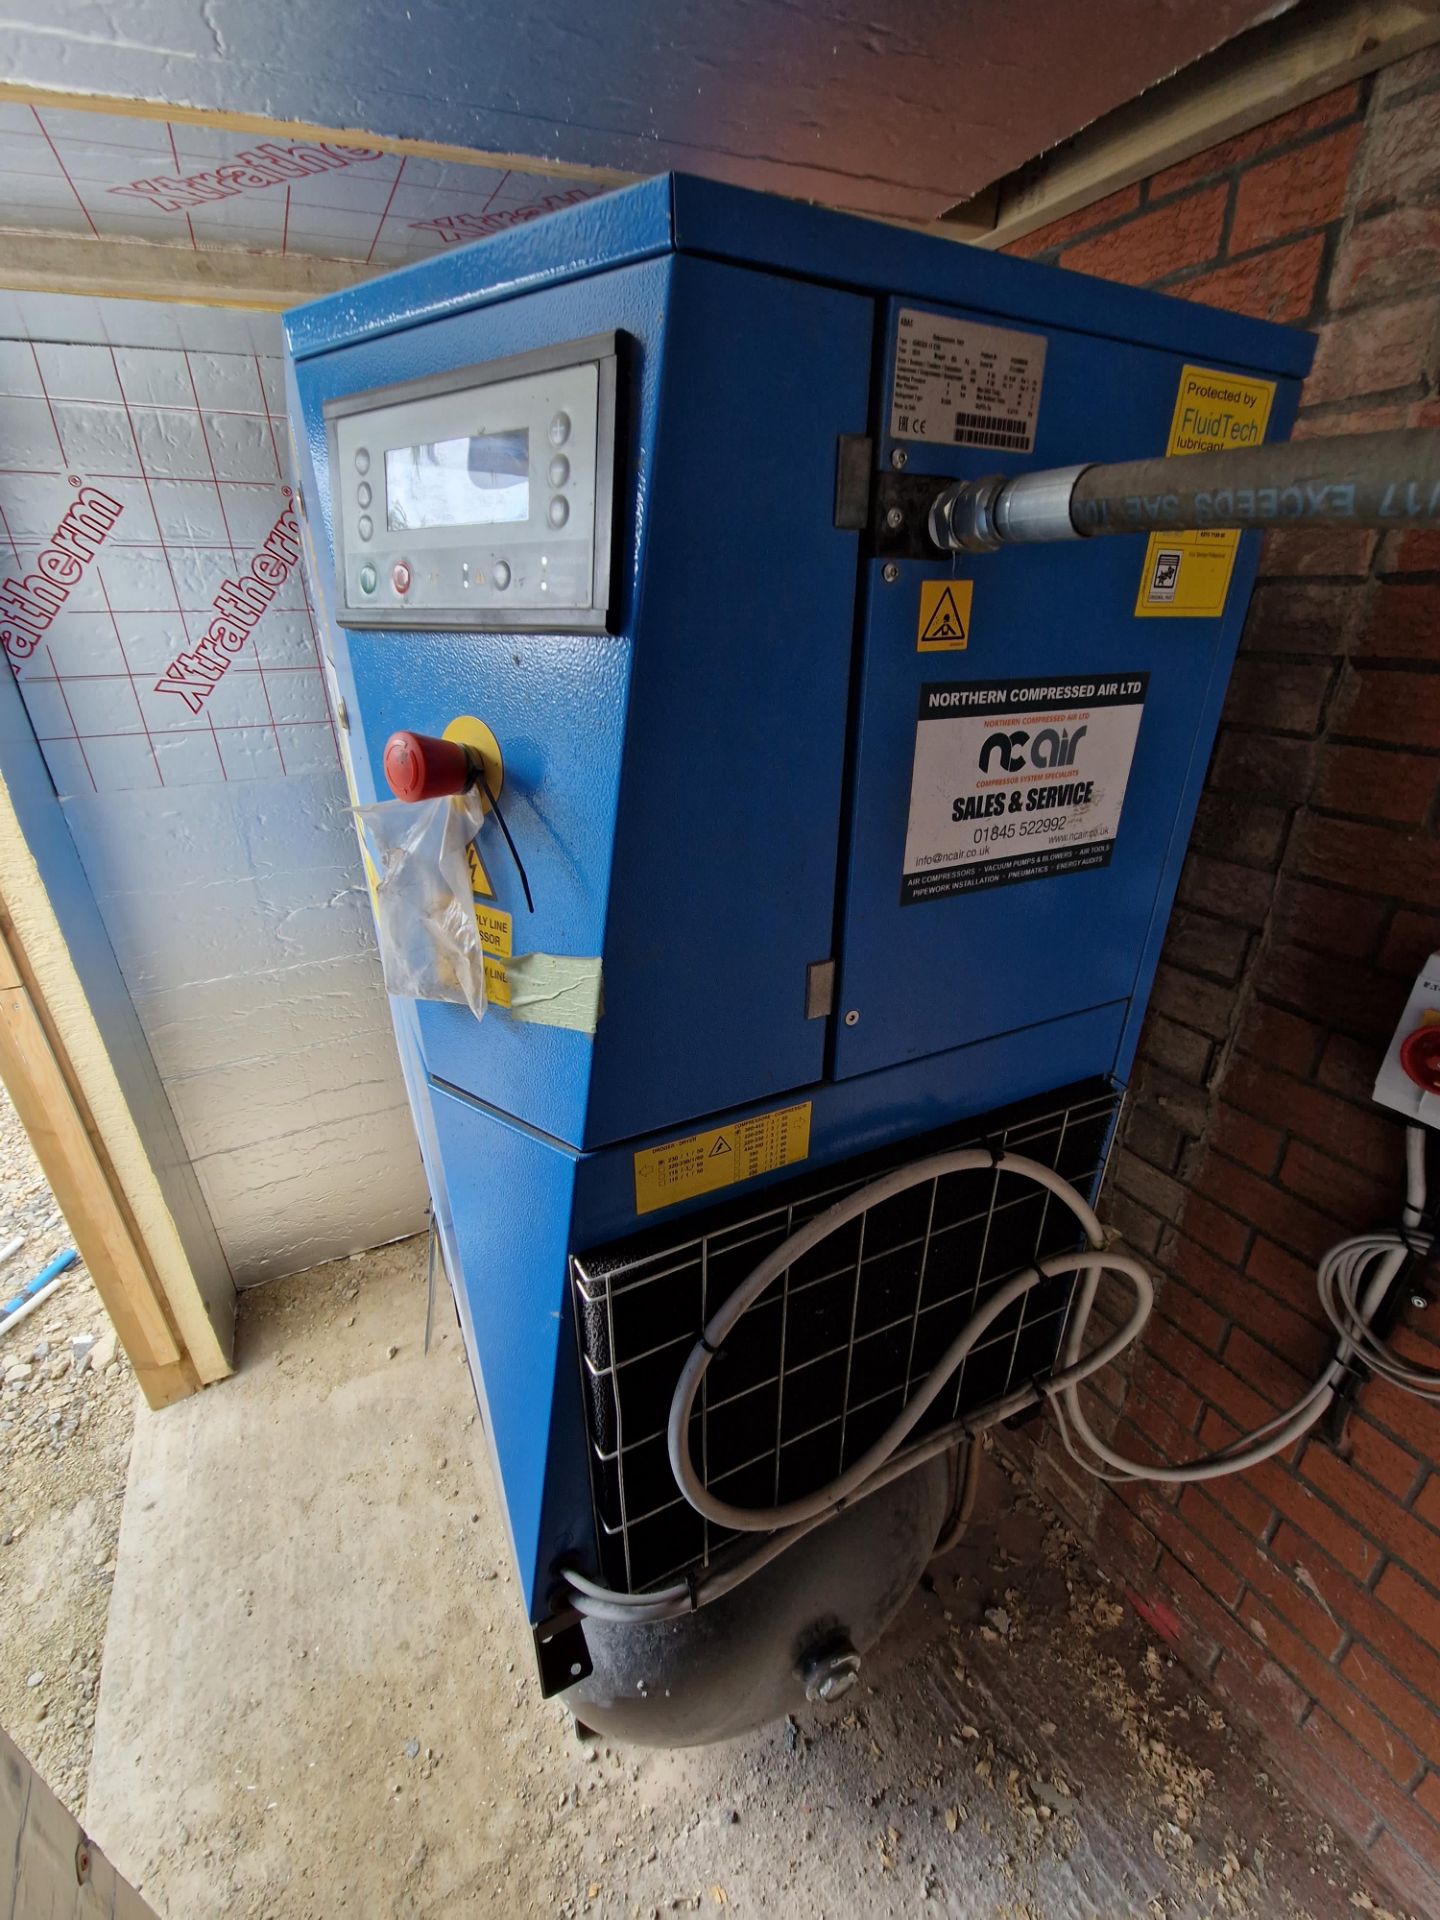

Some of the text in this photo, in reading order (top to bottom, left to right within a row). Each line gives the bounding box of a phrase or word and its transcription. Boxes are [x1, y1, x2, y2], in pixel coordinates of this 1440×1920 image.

[1187, 381, 1258, 408] Protected by
[1181, 407, 1258, 442] FluidTech
[1176, 435, 1224, 452] lubricant
[1125, 494, 1179, 521] SAE
[1194, 484, 1357, 523] EXCEEDS
[929, 681, 1142, 708] NORTHERN COMPRESSED AIR LTD
[1022, 715, 1066, 725] COMPRESSED
[976, 769, 1079, 788] COMPRESSOR SYSTEM SPECIALISTS
[952, 781, 1095, 823] SALES & SERVICE
[973, 816, 1067, 844] 01845 522992
[907, 877, 920, 887] AIR
[921, 867, 976, 885] COMPRESSORS
[983, 861, 1013, 873] VACUUM
[1012, 856, 1036, 868] PUMPS
[1042, 851, 1073, 863] BLOWERS
[1079, 848, 1091, 856] AIR
[1091, 844, 1110, 854] TOOLS
[912, 855, 1103, 897] PIPEWORK INSTALLATION PNEUMATICS ENERGY AUDITS
[489, 918, 508, 934] LINE
